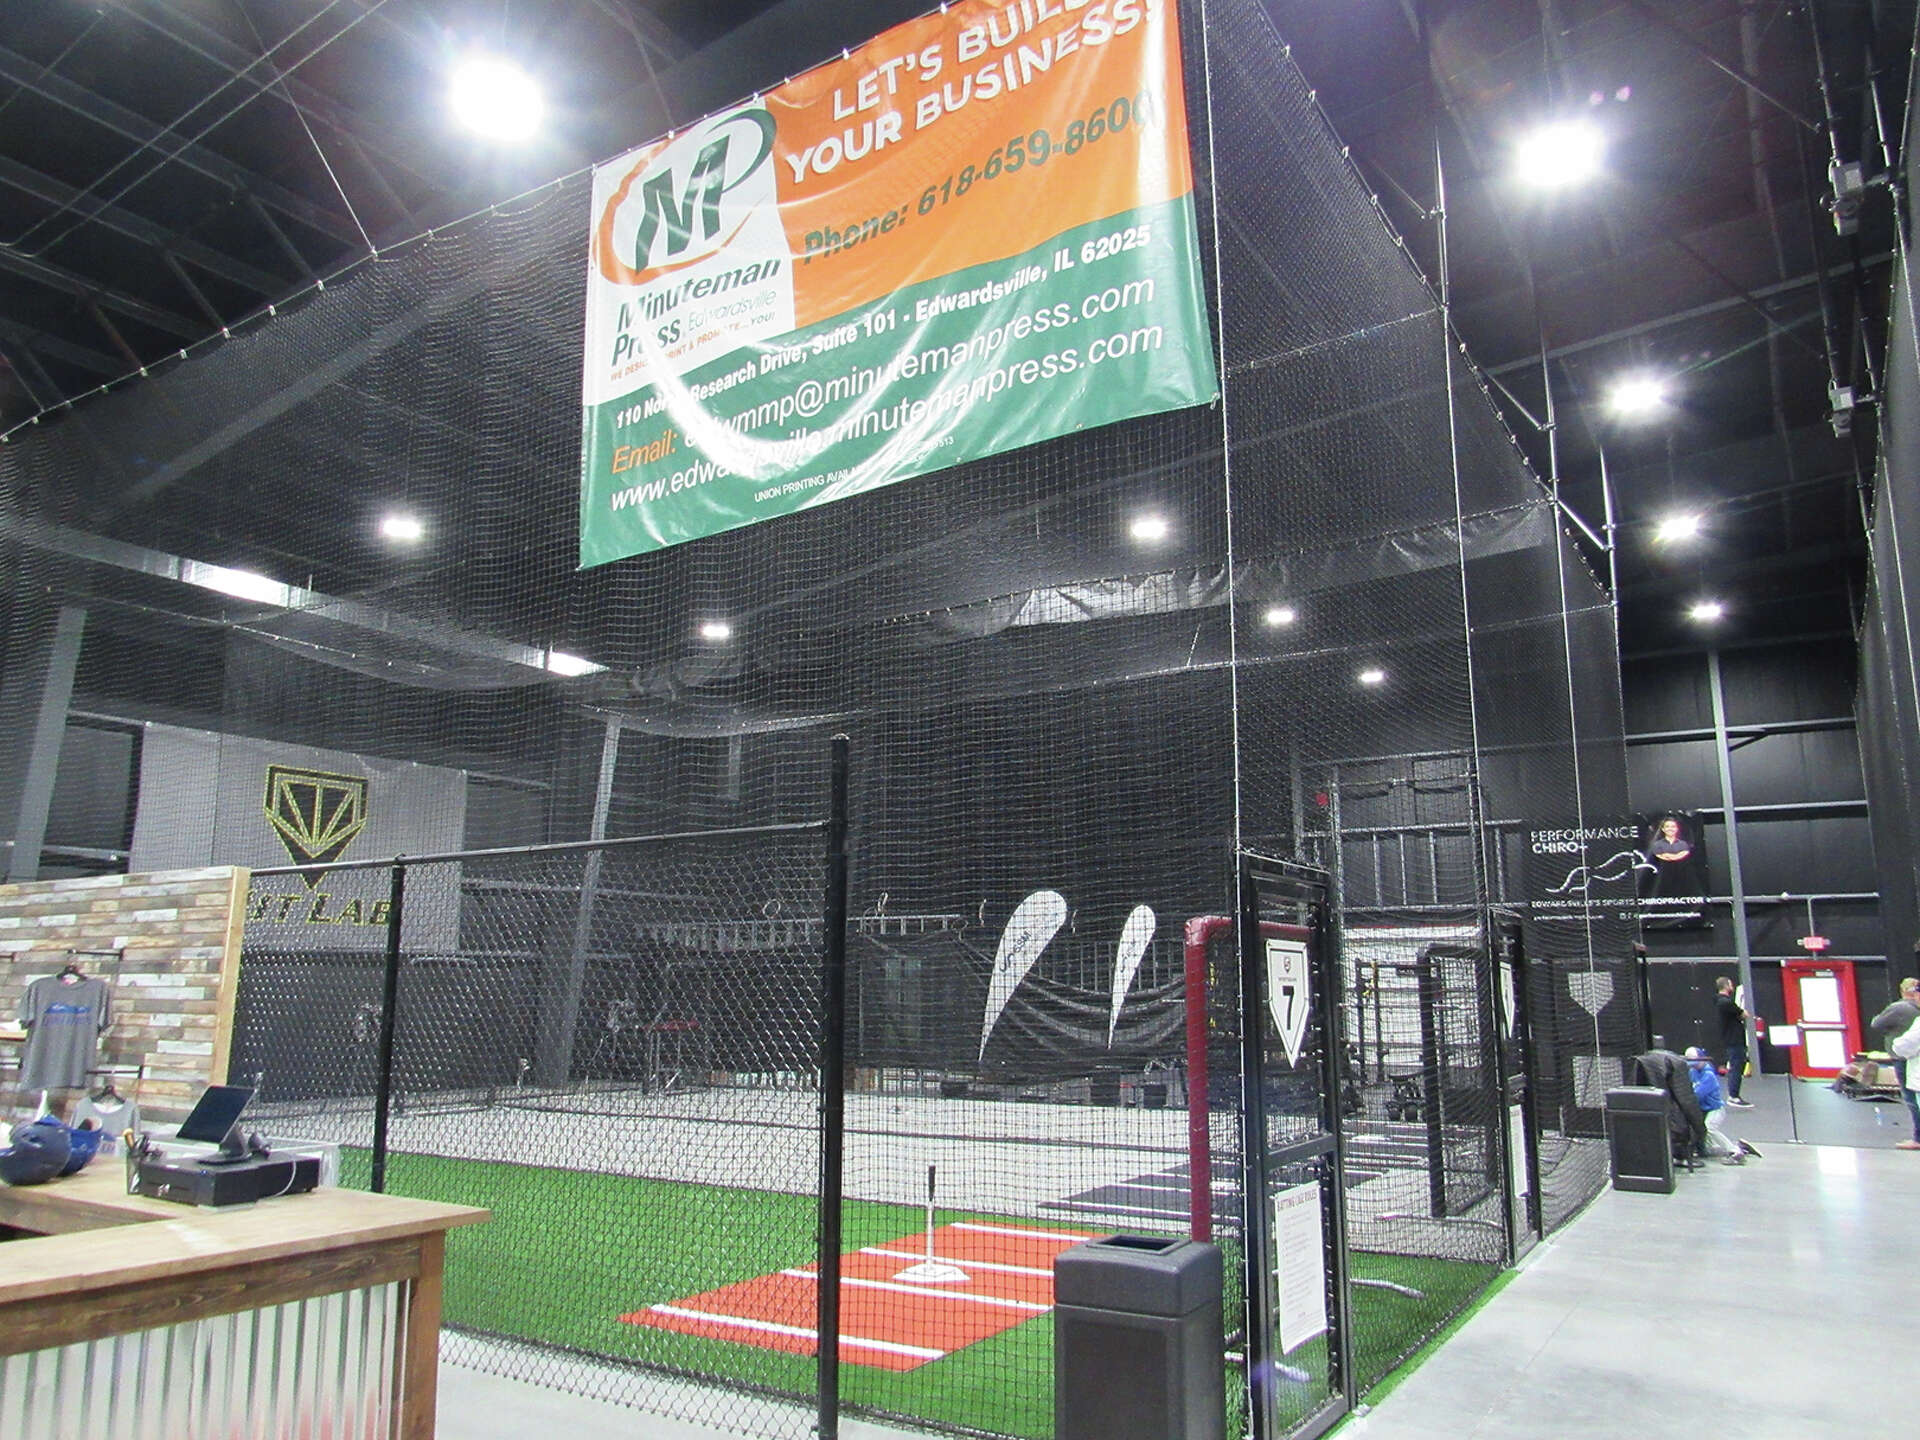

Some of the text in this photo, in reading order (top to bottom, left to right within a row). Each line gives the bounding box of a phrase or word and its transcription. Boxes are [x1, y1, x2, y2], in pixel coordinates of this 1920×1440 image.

[832, 44, 943, 121] LET'S
[785, 111, 902, 184] YOUR
[804, 205, 909, 264] Phone:
[617, 259, 782, 333] Minuteman
[617, 404, 642, 429] 110
[689, 360, 757, 402] Research
[760, 343, 807, 375] Drive,
[812, 325, 859, 355] Suite
[863, 308, 897, 338] 101
[915, 265, 1048, 322] Edwardsville,
[1053, 248, 1075, 273] IL
[1081, 225, 1152, 264] 62025
[611, 277, 1155, 475] Email: ewmmp@minutemanpress.com
[754, 484, 782, 503] UNION
[783, 475, 825, 496] PRINTING
[1530, 825, 1640, 843] PERFORMANCE
[1282, 985, 1295, 1031] 7
